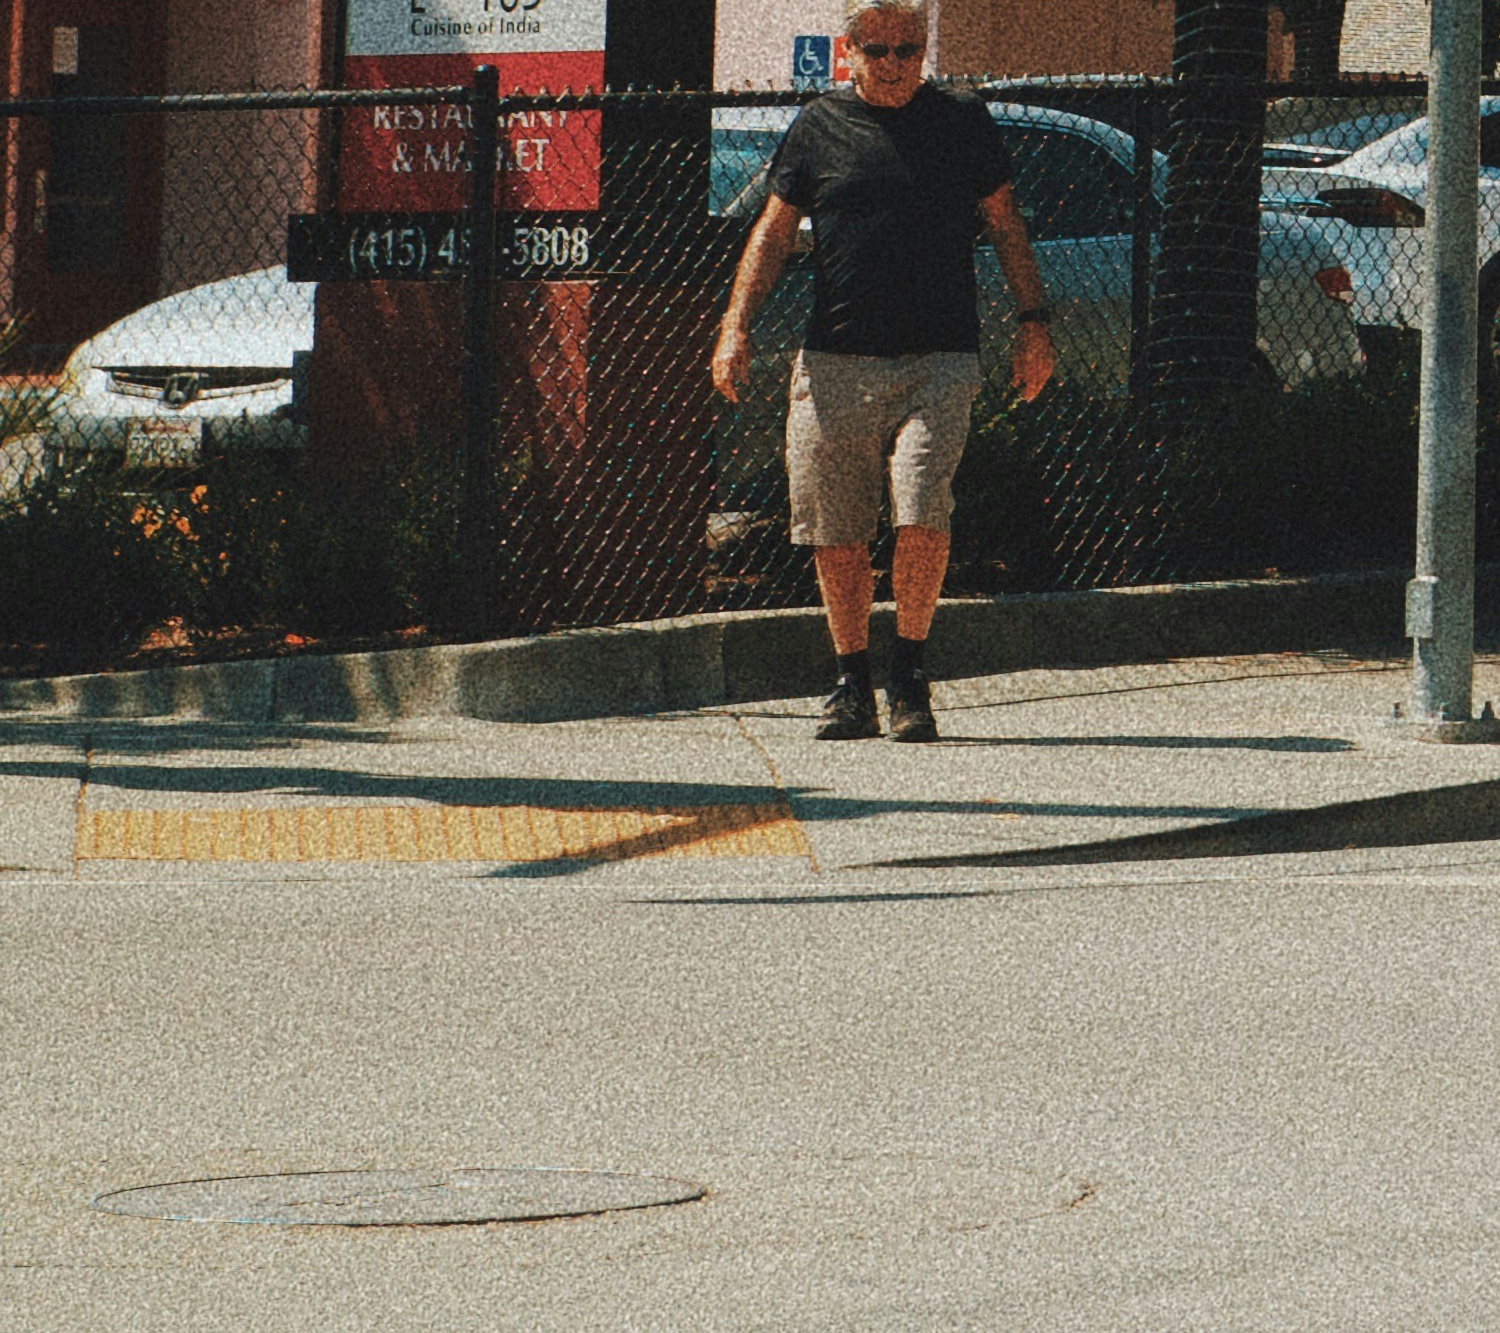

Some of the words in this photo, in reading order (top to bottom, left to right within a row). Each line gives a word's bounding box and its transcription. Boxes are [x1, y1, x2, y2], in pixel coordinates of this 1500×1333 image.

[411, 18, 472, 36] Cuisine
[478, 17, 494, 34] of
[500, 16, 540, 34] India
[392, 142, 414, 173] &
[350, 226, 427, 273] (415)
